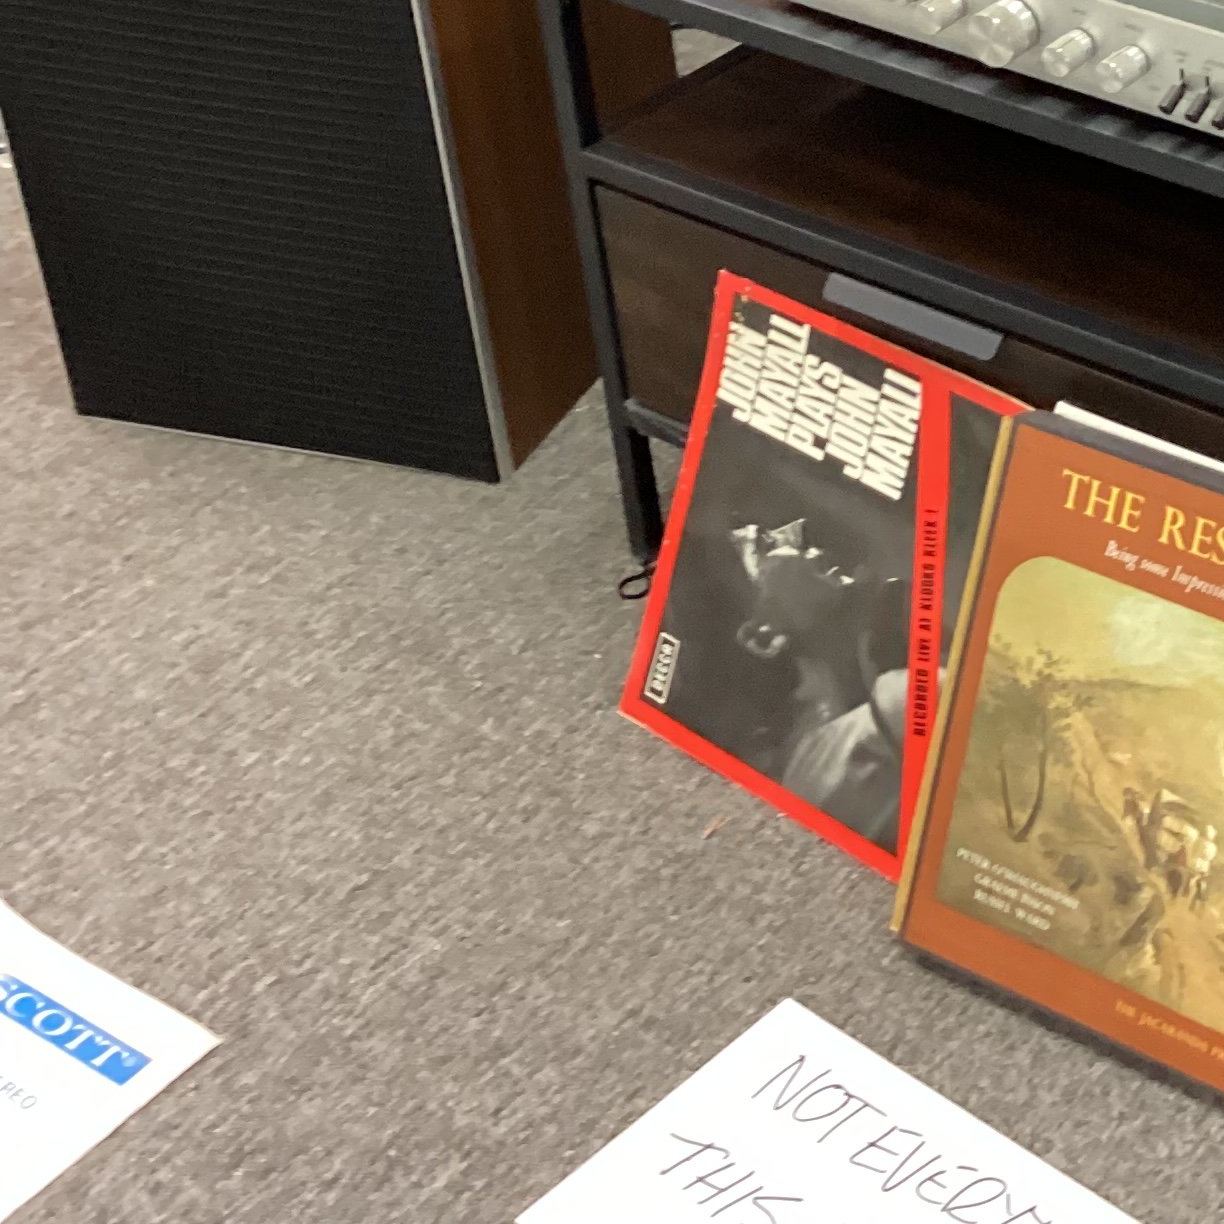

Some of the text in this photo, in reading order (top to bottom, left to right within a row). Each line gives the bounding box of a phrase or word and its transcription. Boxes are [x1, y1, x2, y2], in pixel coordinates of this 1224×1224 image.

[716, 321, 768, 423] JOHN
[749, 313, 811, 443] MAYALL
[785, 353, 843, 461] PLAYS
[824, 373, 882, 480] JOHN
[858, 367, 923, 501] MAYALL
[1062, 467, 1146, 533] THE
[1104, 539, 1140, 572] Being
[917, 638, 931, 662] LIVE
[913, 668, 929, 737] RECORDED
[752, 1055, 1052, 1224] NOT EVERY
